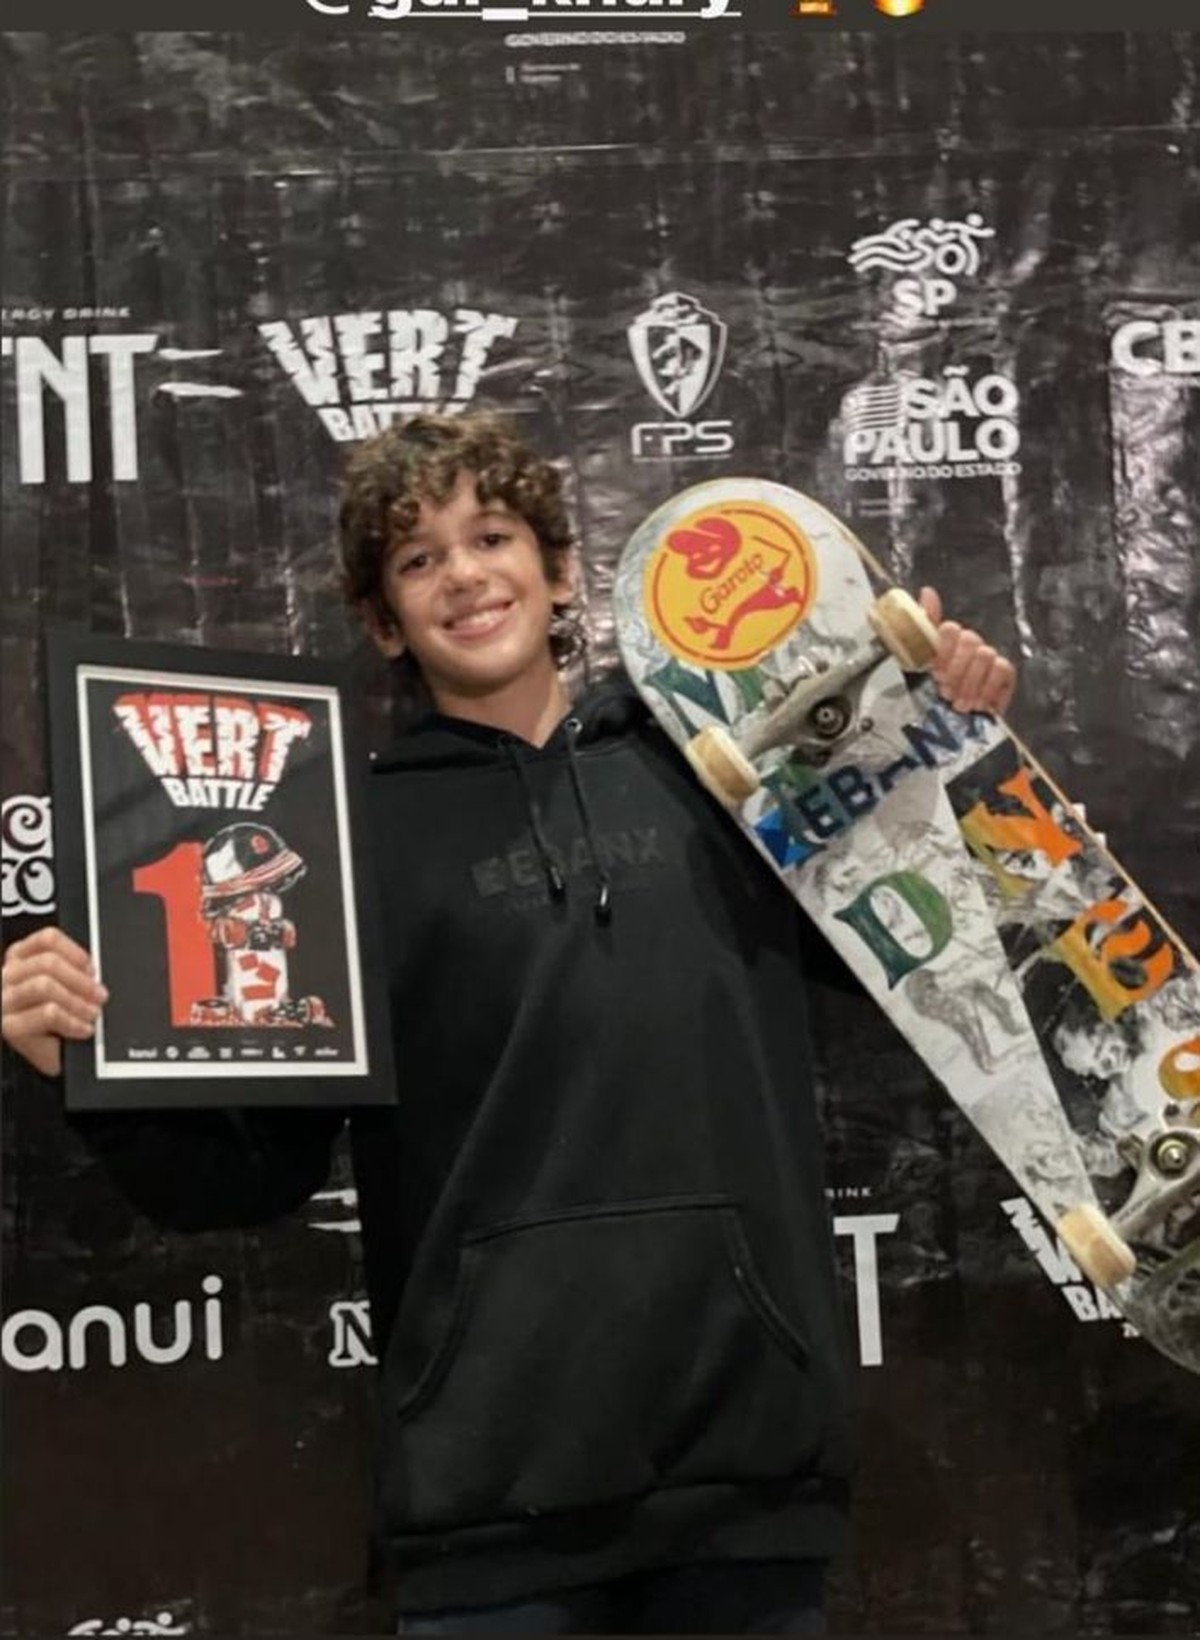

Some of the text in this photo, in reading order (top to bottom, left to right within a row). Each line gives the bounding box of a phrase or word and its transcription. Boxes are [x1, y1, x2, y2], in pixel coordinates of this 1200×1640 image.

[893, 279, 957, 318] SP
[257, 308, 518, 406] VERT
[1, 334, 159, 484] NT
[902, 365, 1020, 421] SÃO
[631, 420, 734, 456] FPS
[844, 417, 1021, 465] PAULO
[699, 552, 764, 615] Garoto
[112, 692, 314, 785] VERT
[160, 777, 276, 812] BATTLE
